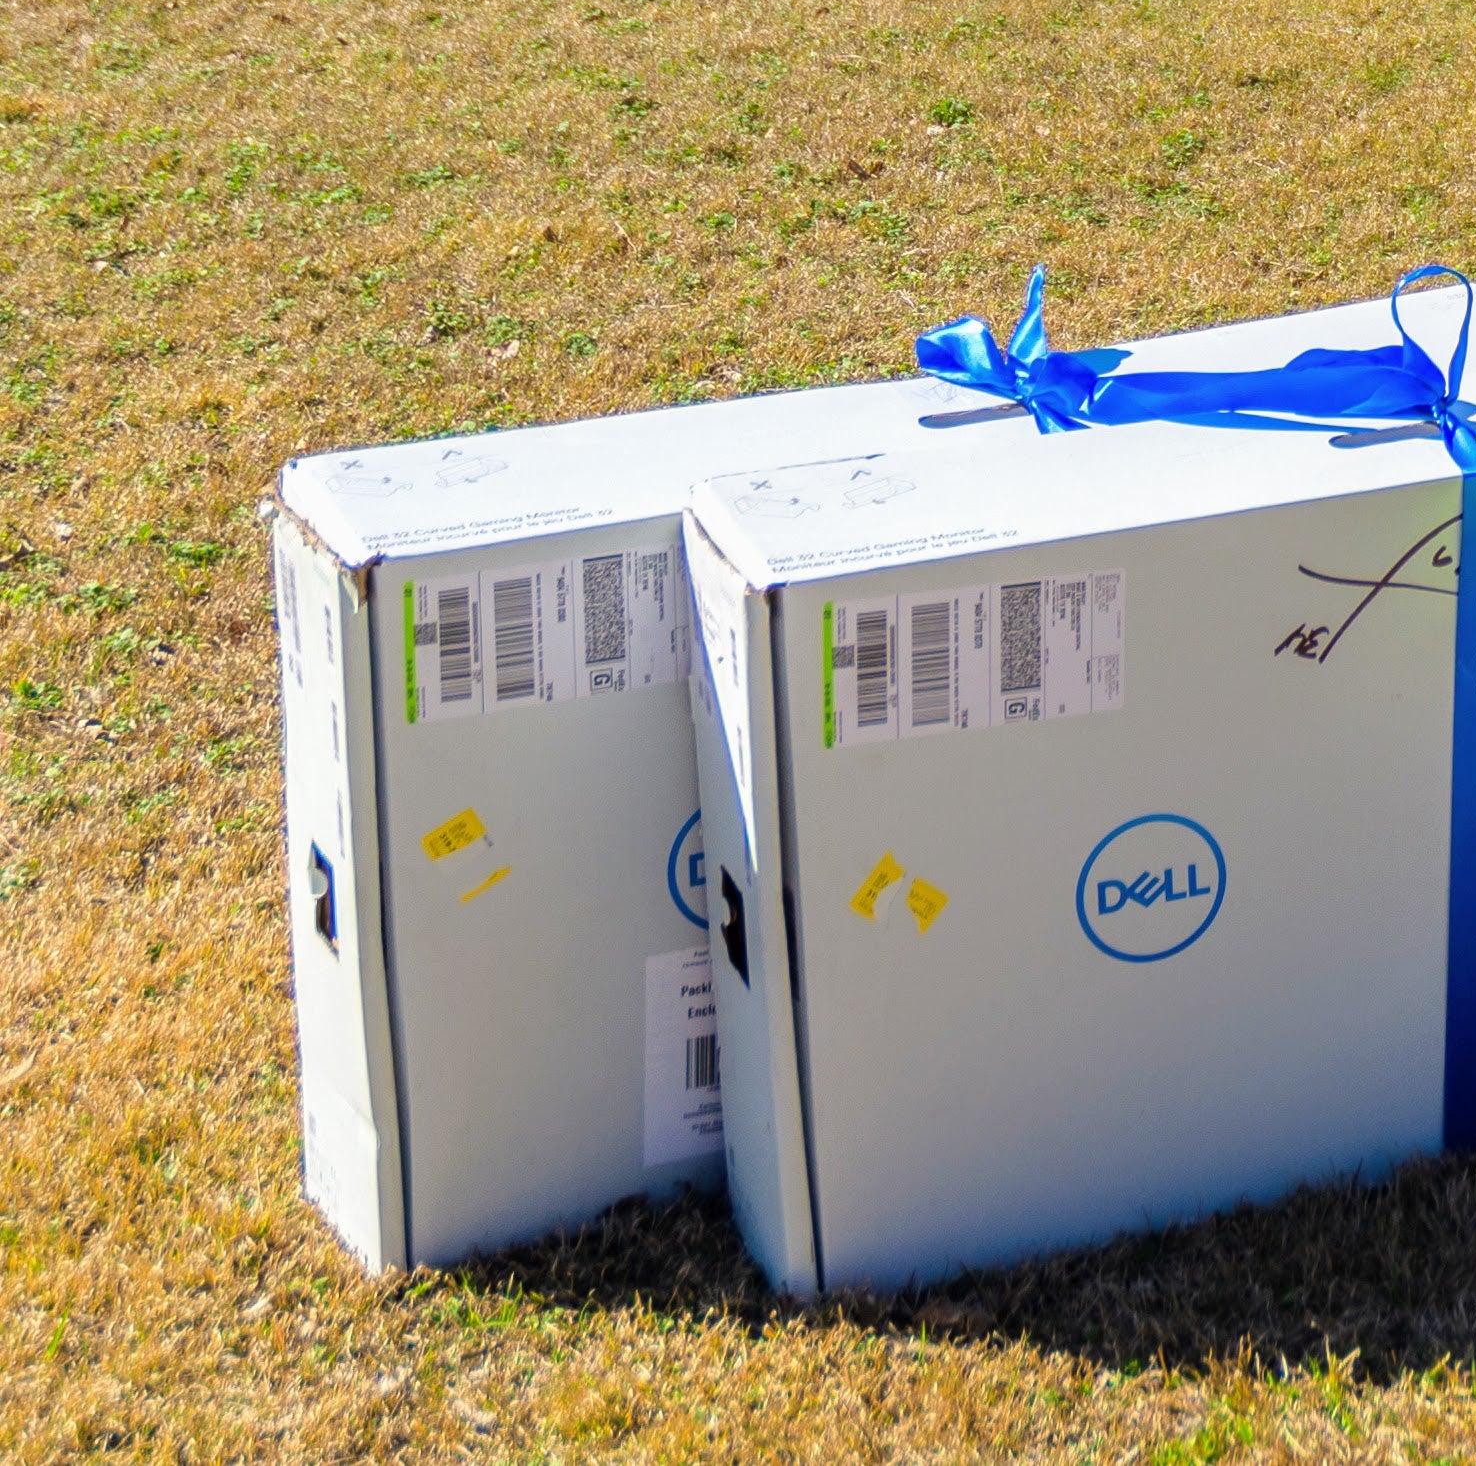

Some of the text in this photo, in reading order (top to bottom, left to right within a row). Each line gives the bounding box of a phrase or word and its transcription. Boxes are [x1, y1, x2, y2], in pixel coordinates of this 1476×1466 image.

[592, 674, 611, 686] G
[1008, 701, 1026, 715] G
[1096, 863, 1212, 916] DELL
